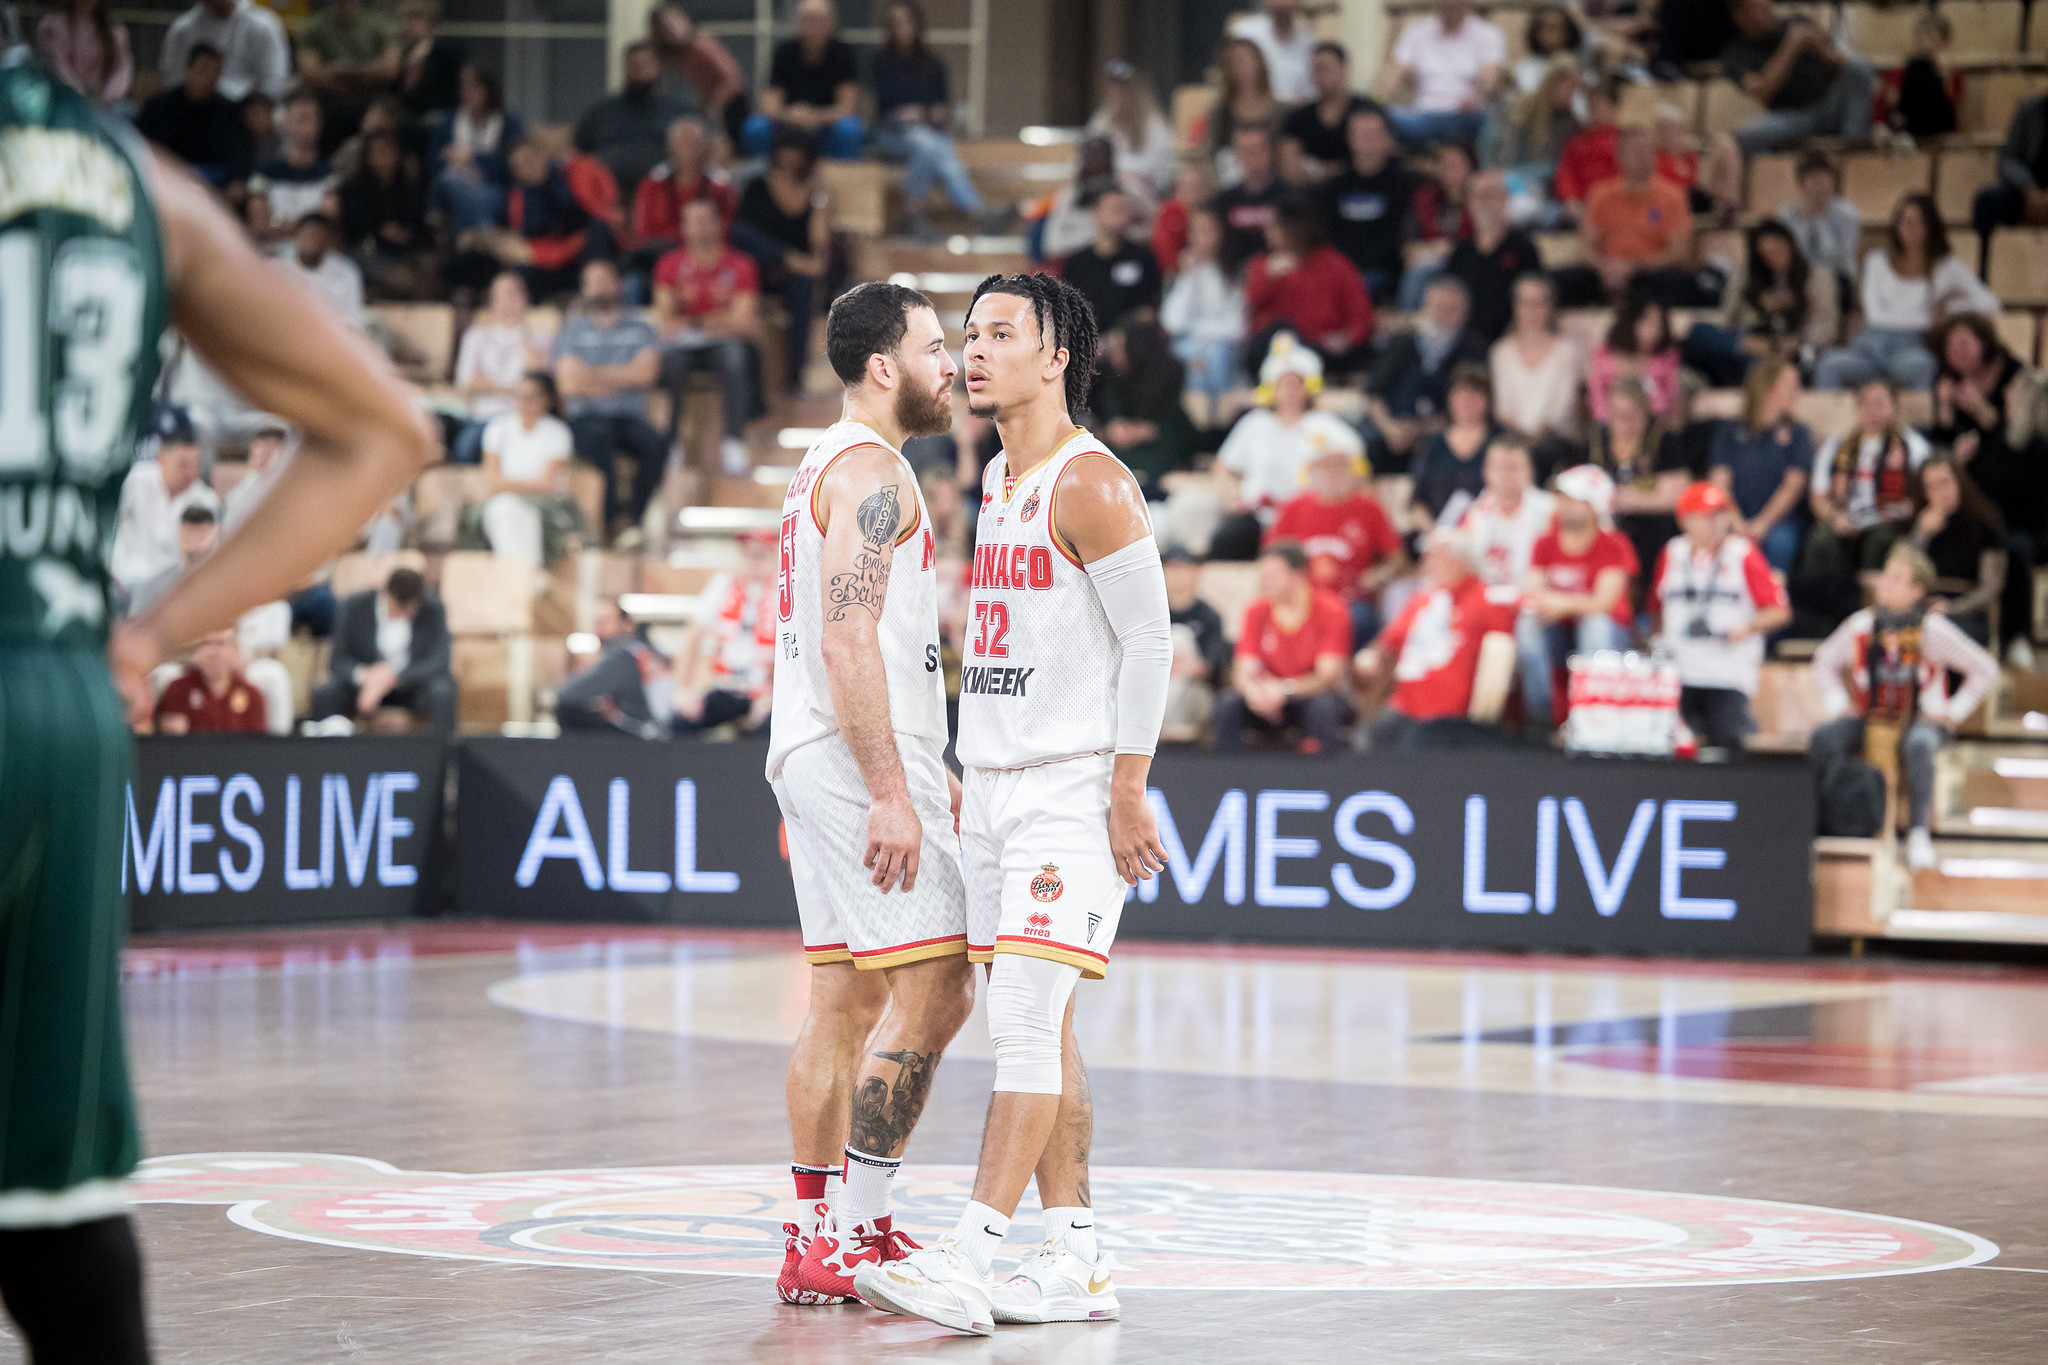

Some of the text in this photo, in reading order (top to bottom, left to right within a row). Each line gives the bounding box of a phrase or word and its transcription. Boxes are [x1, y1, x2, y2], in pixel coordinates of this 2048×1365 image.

[0, 229, 147, 480] 13
[973, 601, 1010, 658] 32
[284, 771, 420, 890] LIVE
[514, 775, 741, 893] ALL
[1462, 794, 1738, 920] LIVE
